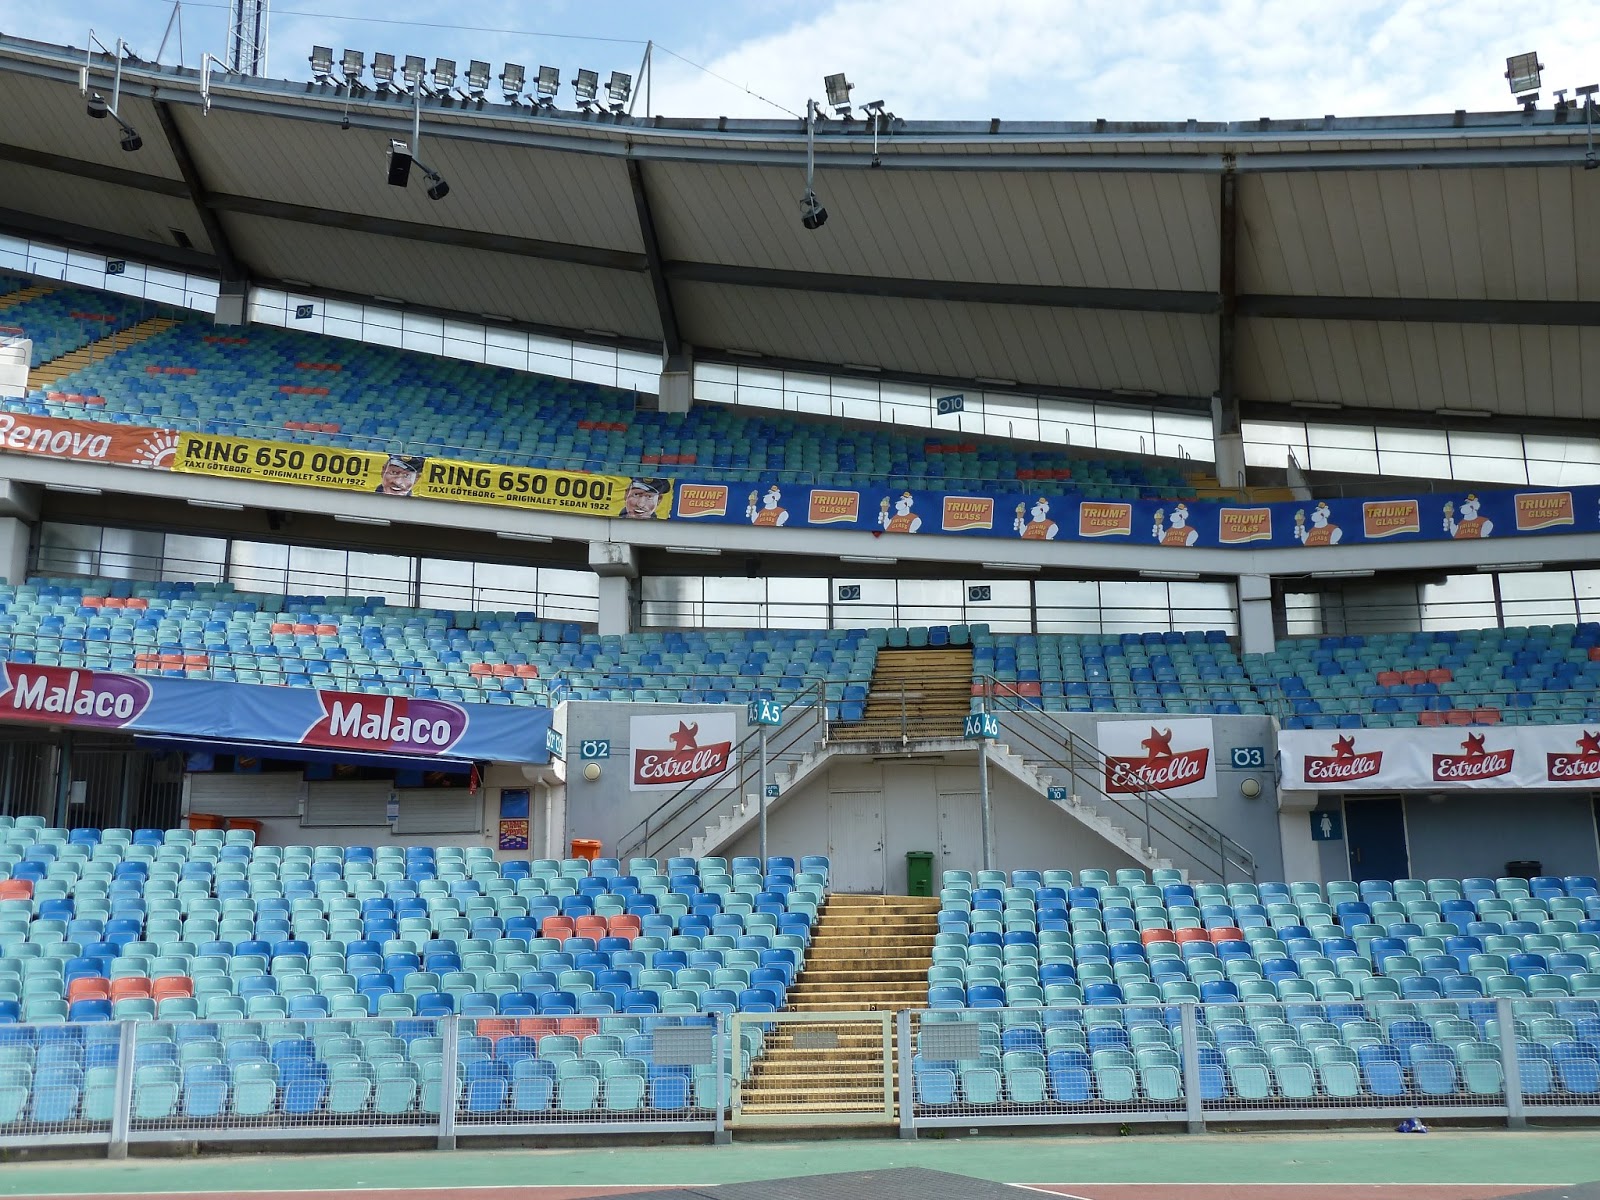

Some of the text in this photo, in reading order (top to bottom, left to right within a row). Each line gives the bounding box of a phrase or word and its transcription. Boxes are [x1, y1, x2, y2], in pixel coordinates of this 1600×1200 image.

[186, 439, 370, 477] RING 650 000!
[184, 460, 205, 469] TAXI
[207, 461, 252, 474] GÖTEBORG
[263, 469, 313, 481] ORIGINALET
[315, 475, 344, 484] SEDAN
[346, 478, 366, 486] 1922
[428, 463, 614, 501] RING 650 000!
[427, 485, 449, 494] TAXI
[450, 486, 495, 499] GÖTEBORG
[506, 494, 558, 505] ORIGINALET
[559, 500, 588, 509] SEDAN
[590, 502, 610, 511] 1922
[682, 489, 724, 500] TRIUMF
[812, 495, 855, 506] TRIUMF
[688, 500, 716, 508] GLASS
[819, 506, 847, 514] GLASS
[947, 502, 989, 513] TRIUMF
[1367, 506, 1414, 518] TRIUMF
[1519, 498, 1567, 510] TRIUMF
[953, 513, 981, 521] GLASS
[1083, 508, 1127, 519] TRIUMF
[1223, 514, 1266, 525] TRIUMF
[1528, 509, 1559, 518] GLASS
[1090, 519, 1119, 527] GLASS
[1231, 525, 1258, 533] GLASS
[1376, 517, 1406, 527] GLASS
[13, 670, 135, 719] Malaco
[761, 701, 780, 722] Ä5
[329, 697, 452, 746] Malaco
[965, 716, 981, 736] Ä6
[984, 714, 998, 735] Ä6
[583, 741, 608, 757] Ö2
[1234, 748, 1261, 765] Ö3
[640, 749, 721, 778] Estrella
[1111, 756, 1200, 787] Estrella
[1308, 757, 1375, 778] Estrella
[1437, 757, 1507, 777] Estrella
[1552, 757, 1600, 776] Estre
[1053, 791, 1061, 799] 10
